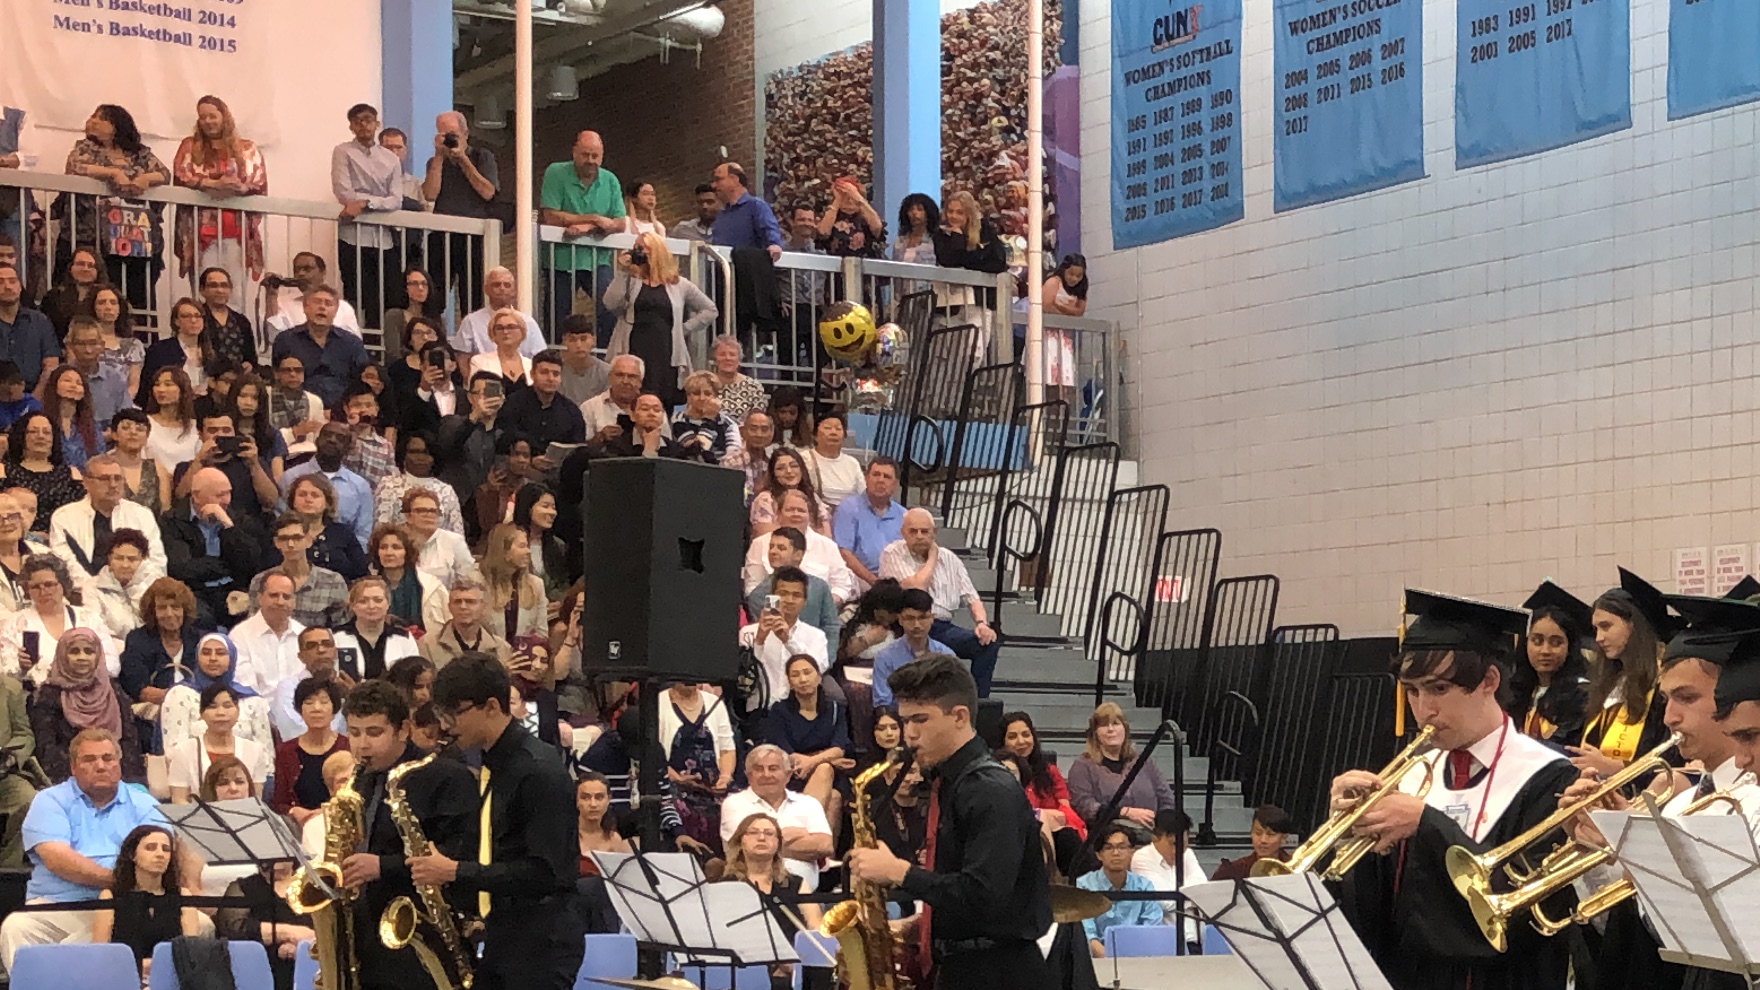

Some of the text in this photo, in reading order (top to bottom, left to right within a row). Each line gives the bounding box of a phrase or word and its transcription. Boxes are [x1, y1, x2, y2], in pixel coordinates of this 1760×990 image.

[53, 14, 237, 53] Men's Basketball 2015
[197, 10, 236, 28] 2014
[1153, 4, 1203, 45] CUNY
[1288, 4, 1348, 37] WOMEN'S
[1306, 18, 1381, 55] CHAMPIONS
[1470, 14, 1499, 38] 1983
[1508, 3, 1536, 27] 1991
[1470, 18, 1572, 64] 2001 2005 2017
[1124, 39, 1233, 87] WOMEN'S SOFTBALL
[1284, 37, 1405, 89] 2004 2005 2006 2007
[1145, 70, 1211, 103] CHAMPIONS
[1316, 83, 1341, 104] 2011
[1350, 73, 1372, 94] 2015
[1381, 62, 1405, 85] 2016
[1181, 97, 1202, 118] 1989
[1285, 115, 1308, 136] 2017
